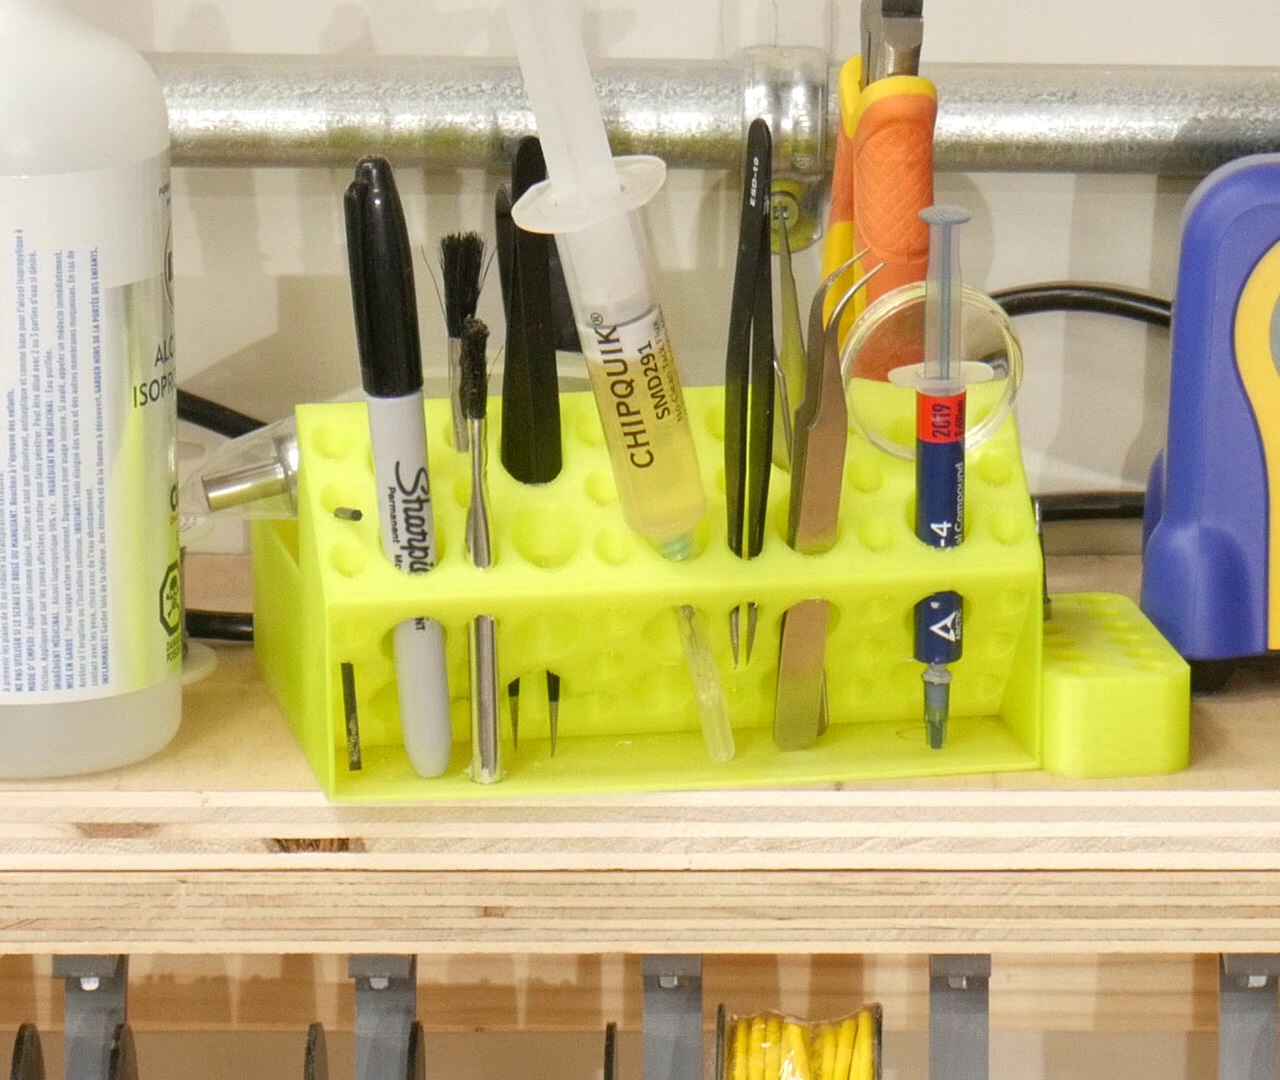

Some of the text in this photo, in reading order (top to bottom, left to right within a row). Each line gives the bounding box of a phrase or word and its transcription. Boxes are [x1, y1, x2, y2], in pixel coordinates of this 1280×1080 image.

[89, 247, 98, 279] ENFANTS.
[89, 297, 99, 322] PORTÉE
[92, 324, 99, 332] LA
[92, 334, 99, 343] DE
[93, 365, 101, 393] GARDER
[638, 339, 671, 420] SMD291
[930, 402, 953, 438] 2019
[951, 460, 966, 530] Compound
[386, 486, 401, 544] Permanent
[11, 583, 19, 594] EST
[14, 668, 22, 680] PAS
